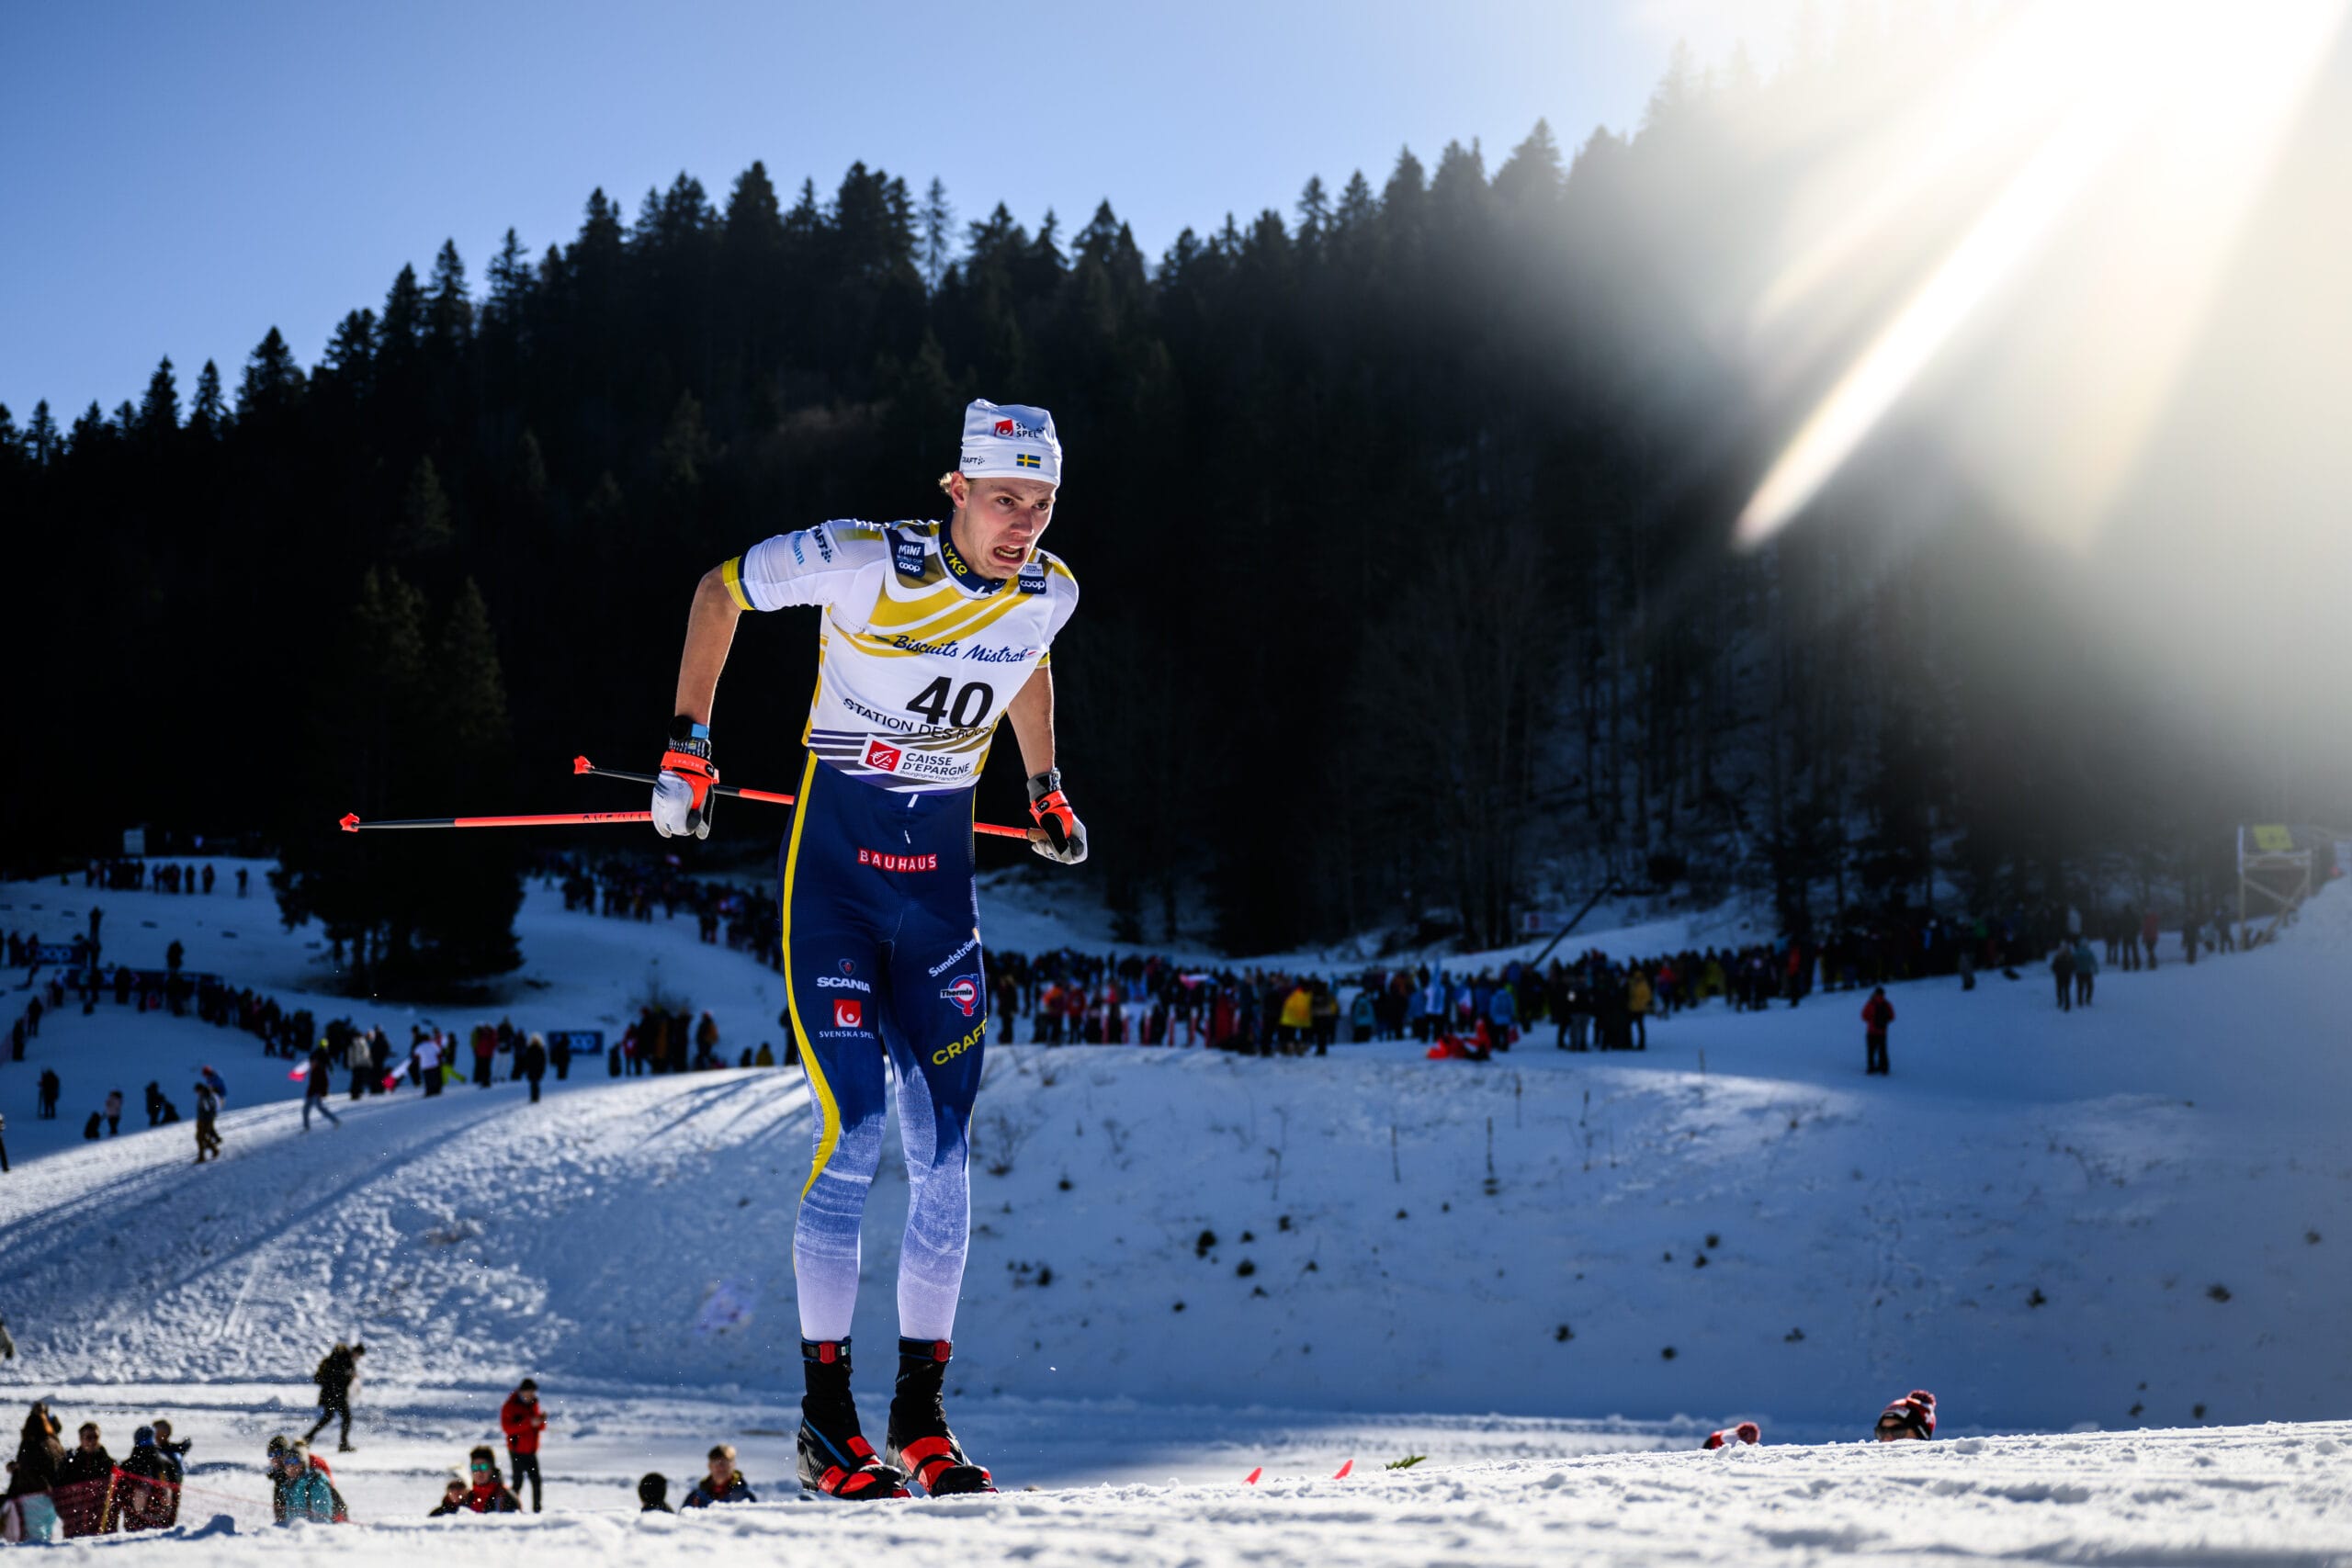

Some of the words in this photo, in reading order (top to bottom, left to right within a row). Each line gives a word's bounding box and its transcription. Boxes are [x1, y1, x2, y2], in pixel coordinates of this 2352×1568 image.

[1016, 430, 1038, 438] SPEL
[899, 562, 921, 572] coop
[1020, 580, 1046, 590] coop
[892, 635, 959, 658] Biscuits
[962, 644, 1028, 662] Mistral
[906, 676, 994, 728] 40
[842, 698, 914, 732] STATION
[919, 723, 953, 740] DES
[902, 761, 970, 775] D'EPARGNE
[906, 753, 953, 766] CAISSE
[859, 849, 937, 870] BAUHAUS
[928, 938, 977, 977] Sundström
[817, 976, 871, 993] SCANIA
[942, 988, 973, 998] Thermia
[932, 1019, 988, 1065] CRAFT
